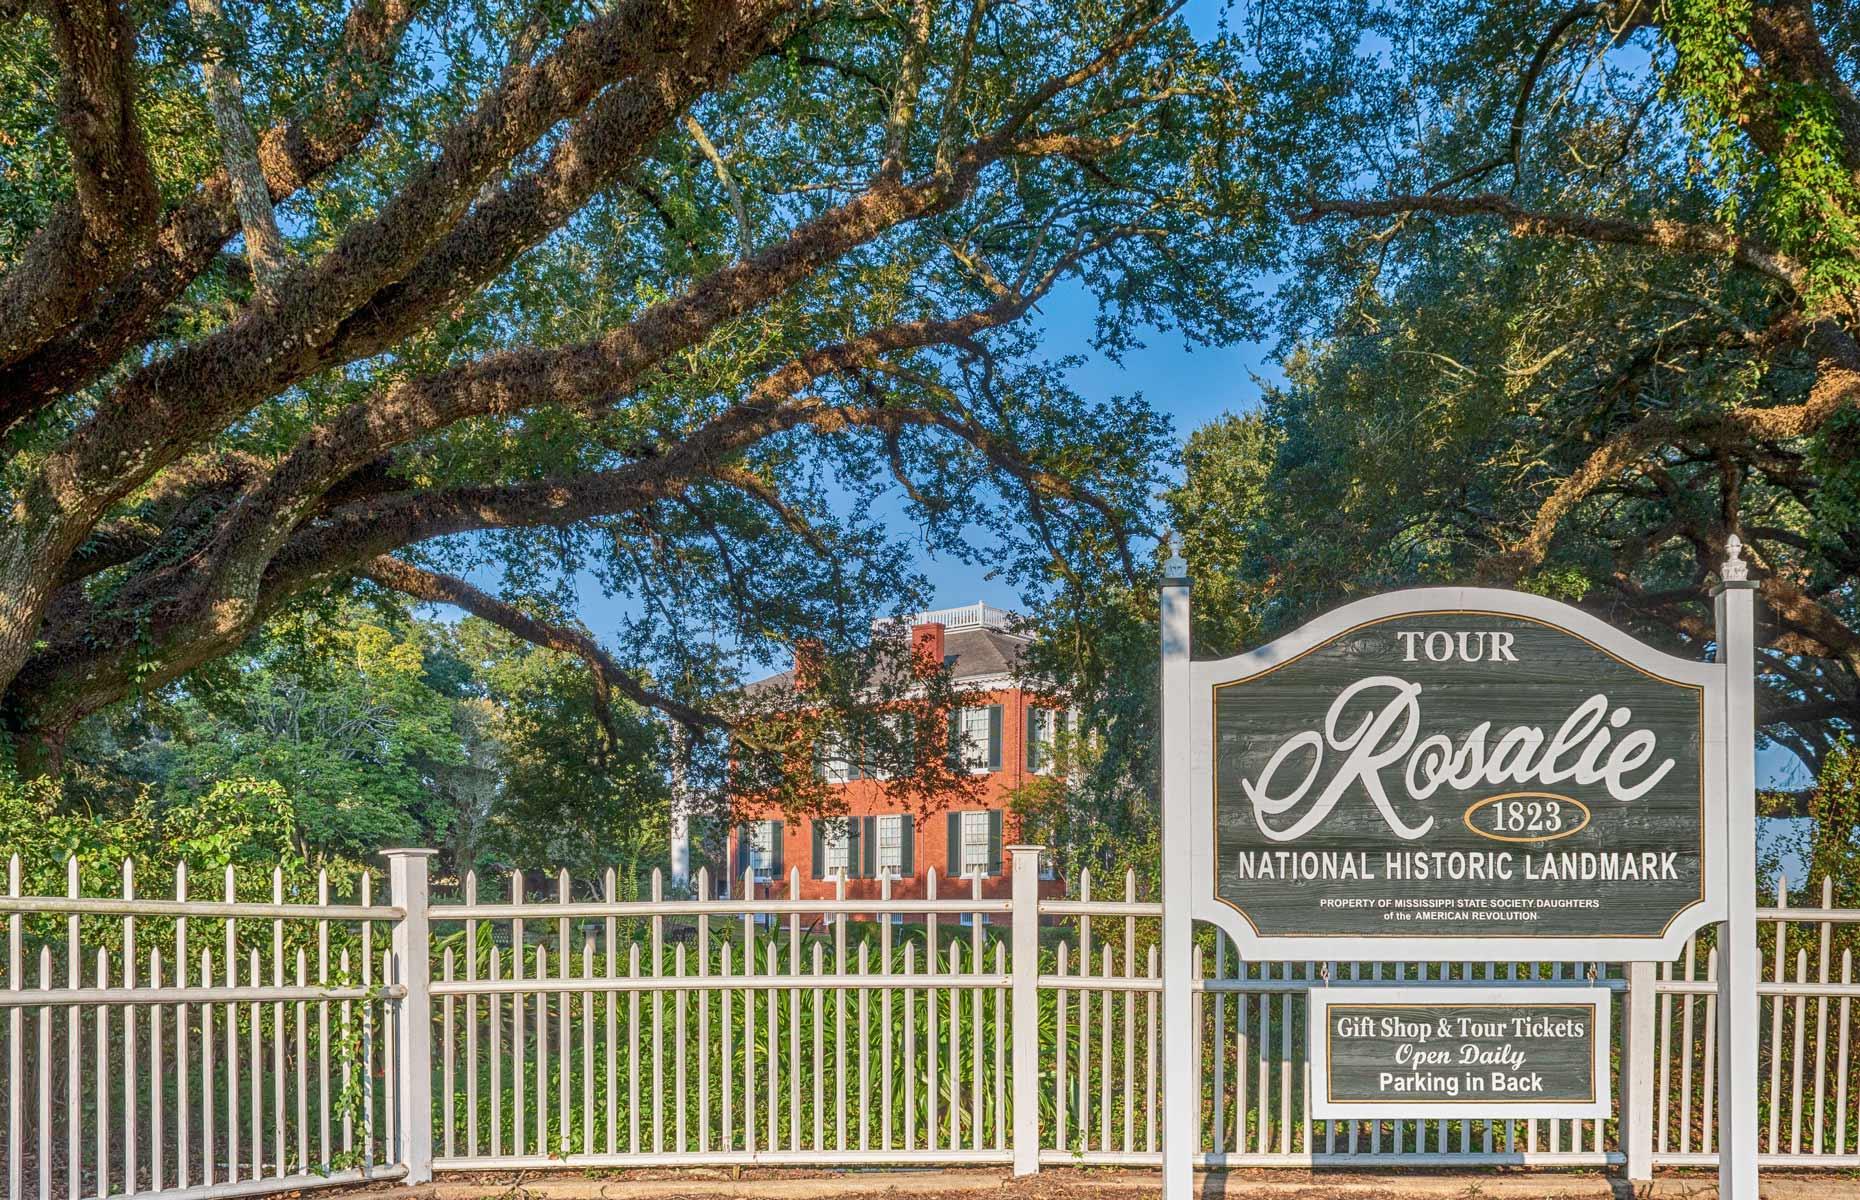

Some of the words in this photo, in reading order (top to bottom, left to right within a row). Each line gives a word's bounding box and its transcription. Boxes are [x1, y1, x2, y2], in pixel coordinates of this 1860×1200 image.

[1397, 630, 1520, 662] TOUR
[1241, 675, 1676, 841] Rosalie
[1492, 801, 1562, 832] 1823
[1239, 851, 1375, 880] NATIONAL
[1386, 851, 1513, 880] HISTORIC
[1525, 851, 1679, 881] LANDMARK
[1320, 898, 1375, 908] PROPERTY
[1378, 898, 1392, 908] OF
[1395, 898, 1454, 908] MISSISSIPPI
[1457, 898, 1487, 908] STATE
[1490, 898, 1534, 908] SOCIETY
[1537, 898, 1599, 908] DAUGHTERS
[1384, 911, 1394, 921] of
[1396, 911, 1411, 921] the
[1416, 911, 1468, 921] AMERICAN
[1472, 911, 1537, 921] REVOLUTION
[1337, 1016, 1377, 1038] Gift
[1380, 1016, 1432, 1043] Shop
[1436, 1017, 1454, 1038] &
[1456, 1017, 1508, 1038] Tour
[1511, 1016, 1585, 1038] Tickets
[1394, 1043, 1452, 1071] Open
[1457, 1043, 1527, 1072] Daily
[1379, 1071, 1459, 1097] Parking
[1465, 1071, 1485, 1092] in
[1491, 1071, 1544, 1092] Back
